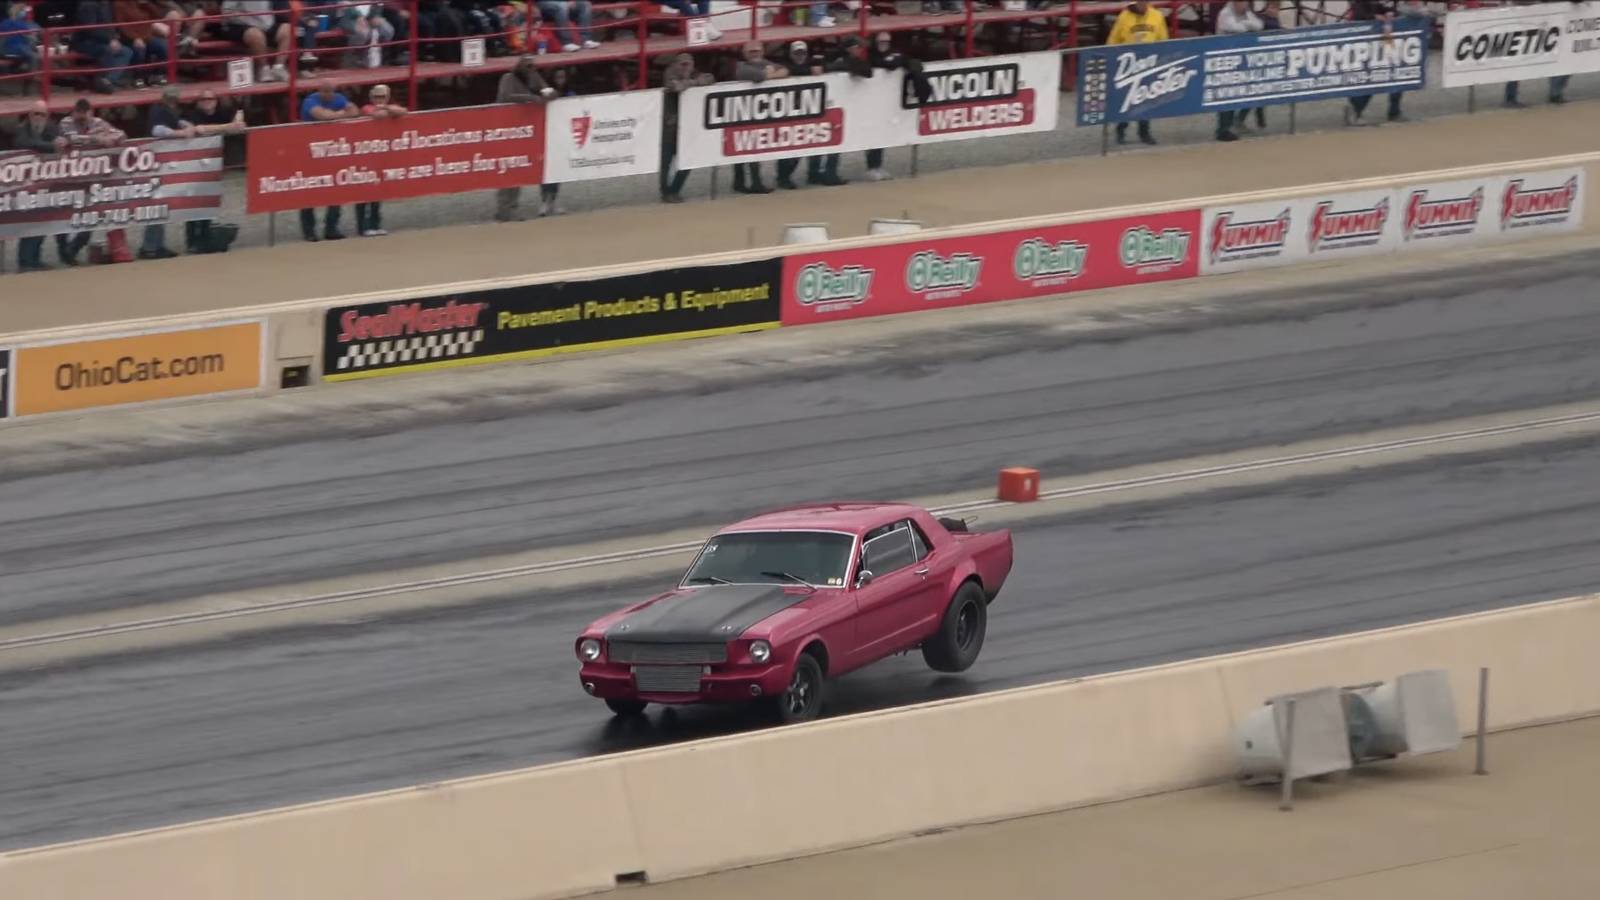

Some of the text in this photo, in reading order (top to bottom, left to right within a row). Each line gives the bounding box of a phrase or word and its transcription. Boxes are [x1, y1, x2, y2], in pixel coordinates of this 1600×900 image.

[1204, 50, 1286, 72] KEEP YOUR
[1287, 36, 1423, 77] PUMPING
[1455, 26, 1560, 61] COMETIC
[1116, 51, 1158, 82] Don
[905, 68, 1015, 105] LNCOLN
[1117, 68, 1198, 113] Tester
[707, 87, 824, 126] LINCOLN
[927, 101, 1025, 131] WELDERS
[309, 137, 351, 158] With
[391, 131, 411, 151] of
[411, 128, 482, 150] locations
[484, 124, 534, 141] across
[732, 122, 833, 152] WELDERS
[0, 146, 160, 184] ortation Co.
[259, 153, 533, 193] Northern Ohio, we are here for you.
[16, 188, 86, 209] Delivery
[337, 300, 485, 343] SealMaster
[497, 283, 770, 331] Pavement Products & Equipment
[55, 353, 225, 391] OhioCat.com
